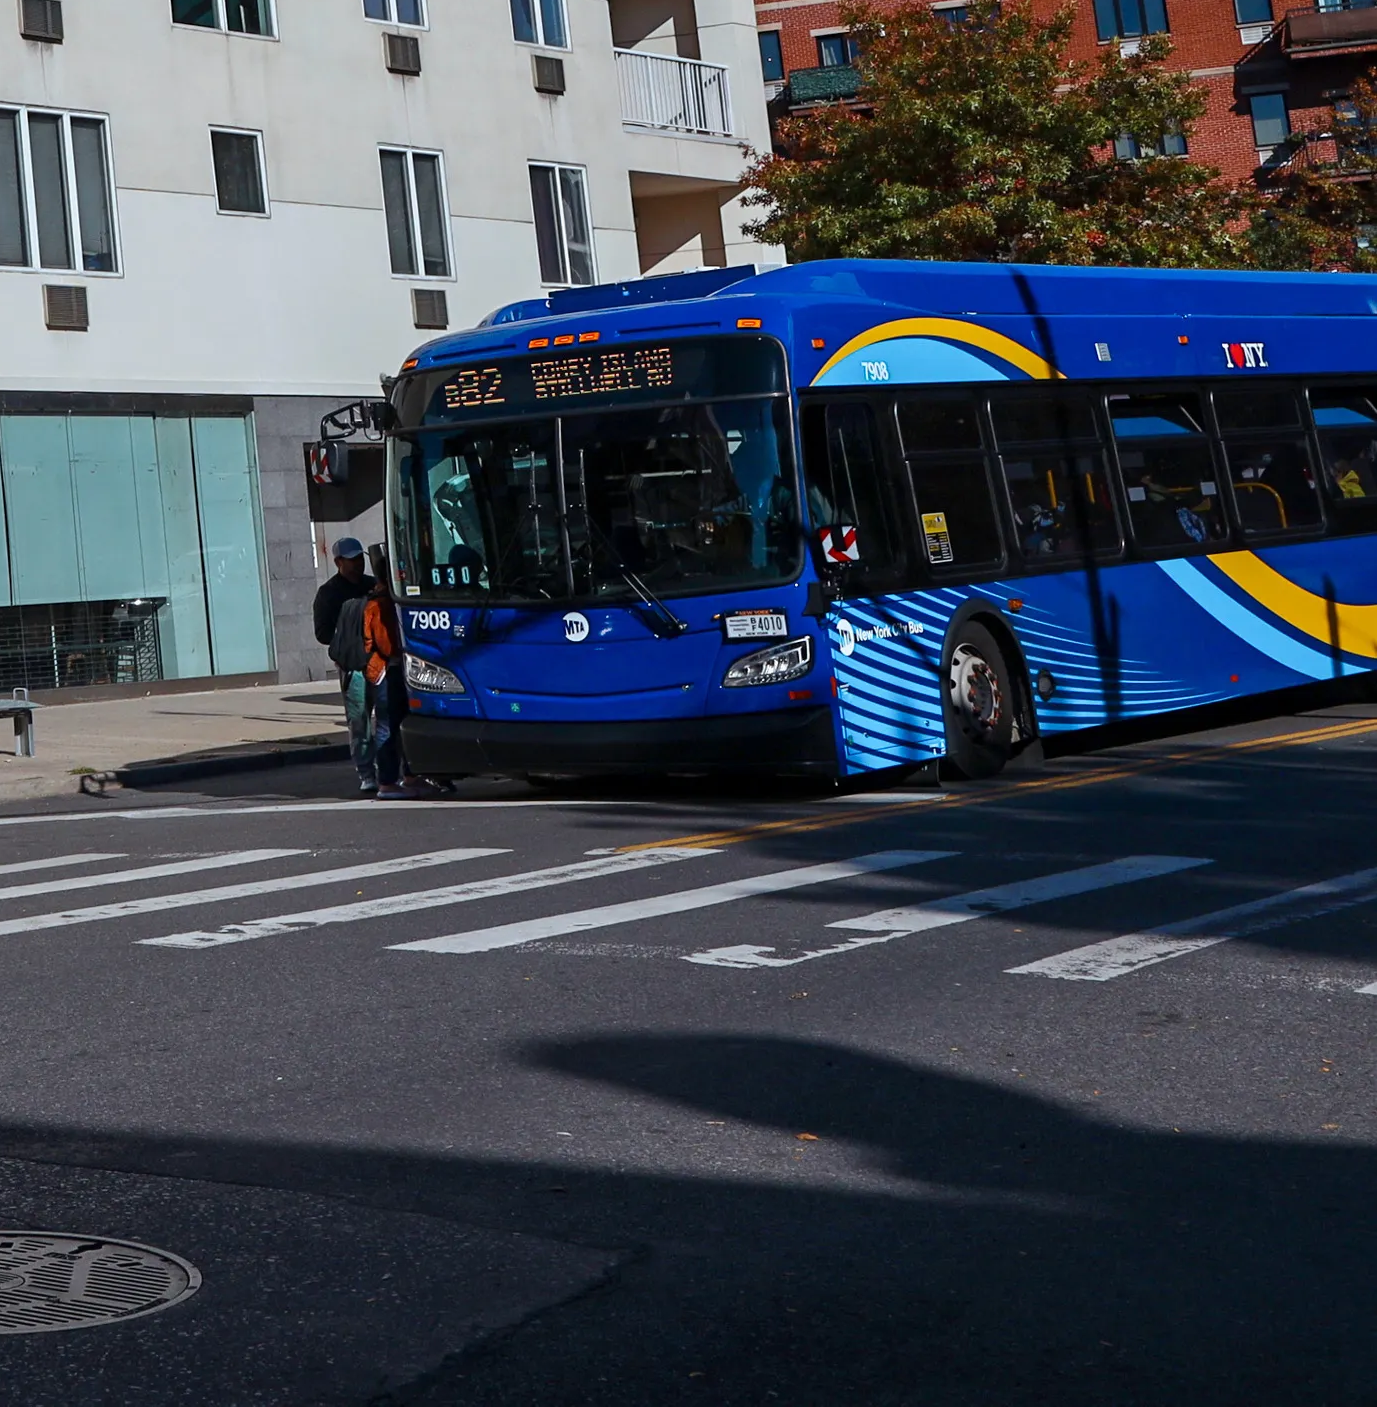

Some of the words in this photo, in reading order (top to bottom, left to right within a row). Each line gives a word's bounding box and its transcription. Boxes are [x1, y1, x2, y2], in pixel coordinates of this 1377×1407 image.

[531, 357, 591, 380] CONEY
[600, 348, 672, 372] ISLAND
[861, 361, 889, 381] 7908
[445, 368, 505, 408] B82
[535, 372, 642, 398] STILLWELL
[409, 611, 450, 630] 7908
[564, 619, 585, 635] MTA
[758, 616, 783, 631] 4010
[856, 628, 873, 642] New
[873, 624, 892, 639] York
[908, 621, 924, 634] Bus
